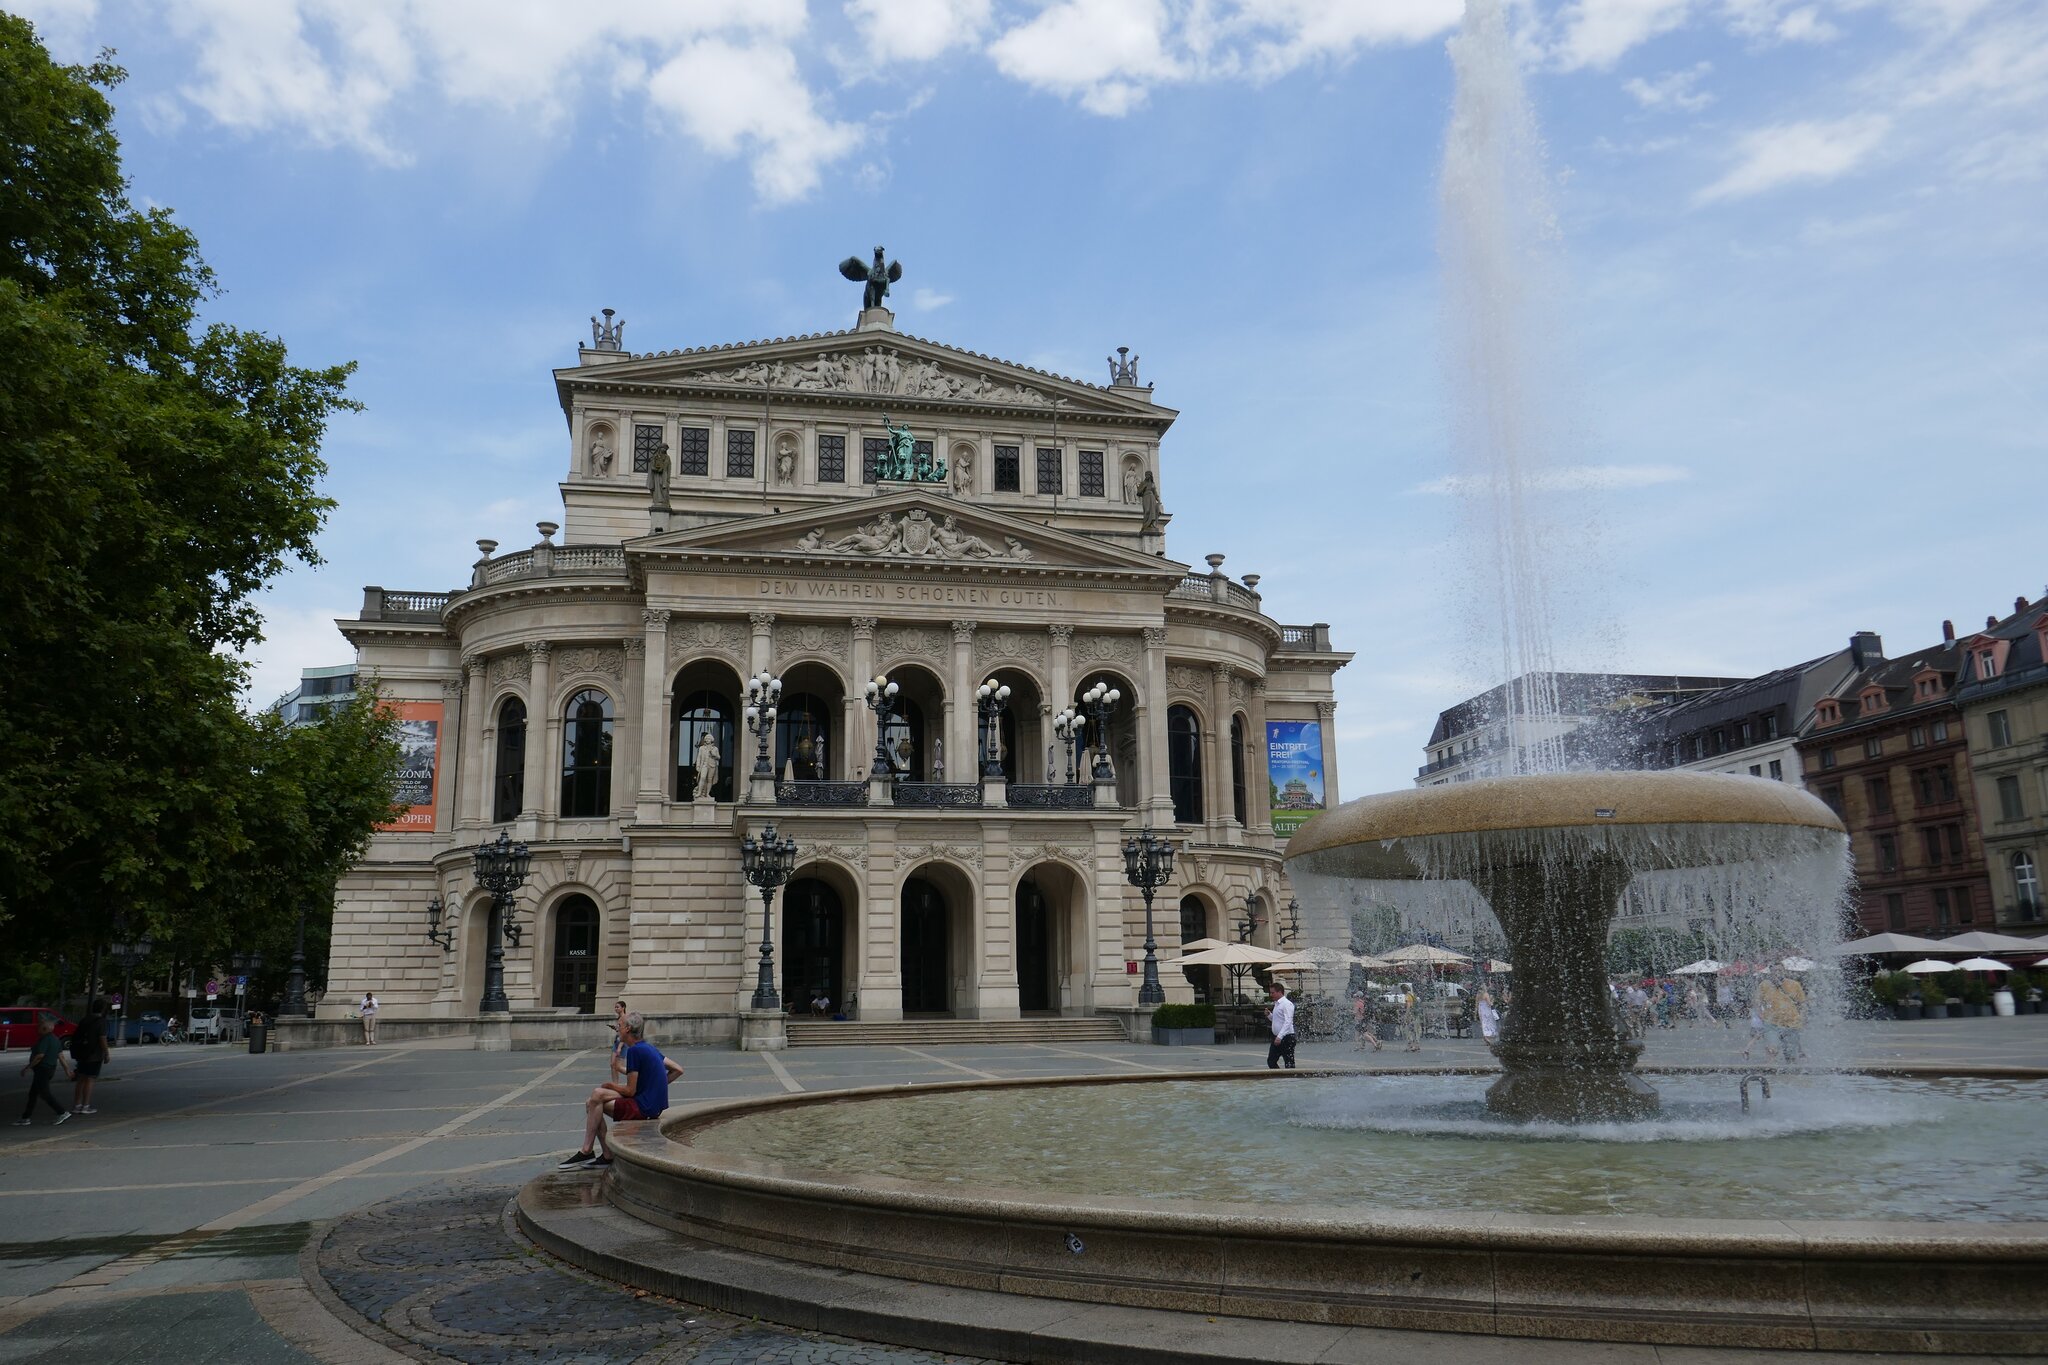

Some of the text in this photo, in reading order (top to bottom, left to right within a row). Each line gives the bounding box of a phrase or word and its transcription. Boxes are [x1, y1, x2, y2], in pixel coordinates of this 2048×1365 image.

[759, 580, 1064, 606] DEM WAHREN SCHOENEN GUTEN.
[1270, 742, 1308, 751] EINTRITT
[401, 814, 431, 824] OPER
[1274, 823, 1298, 831] ALTE
